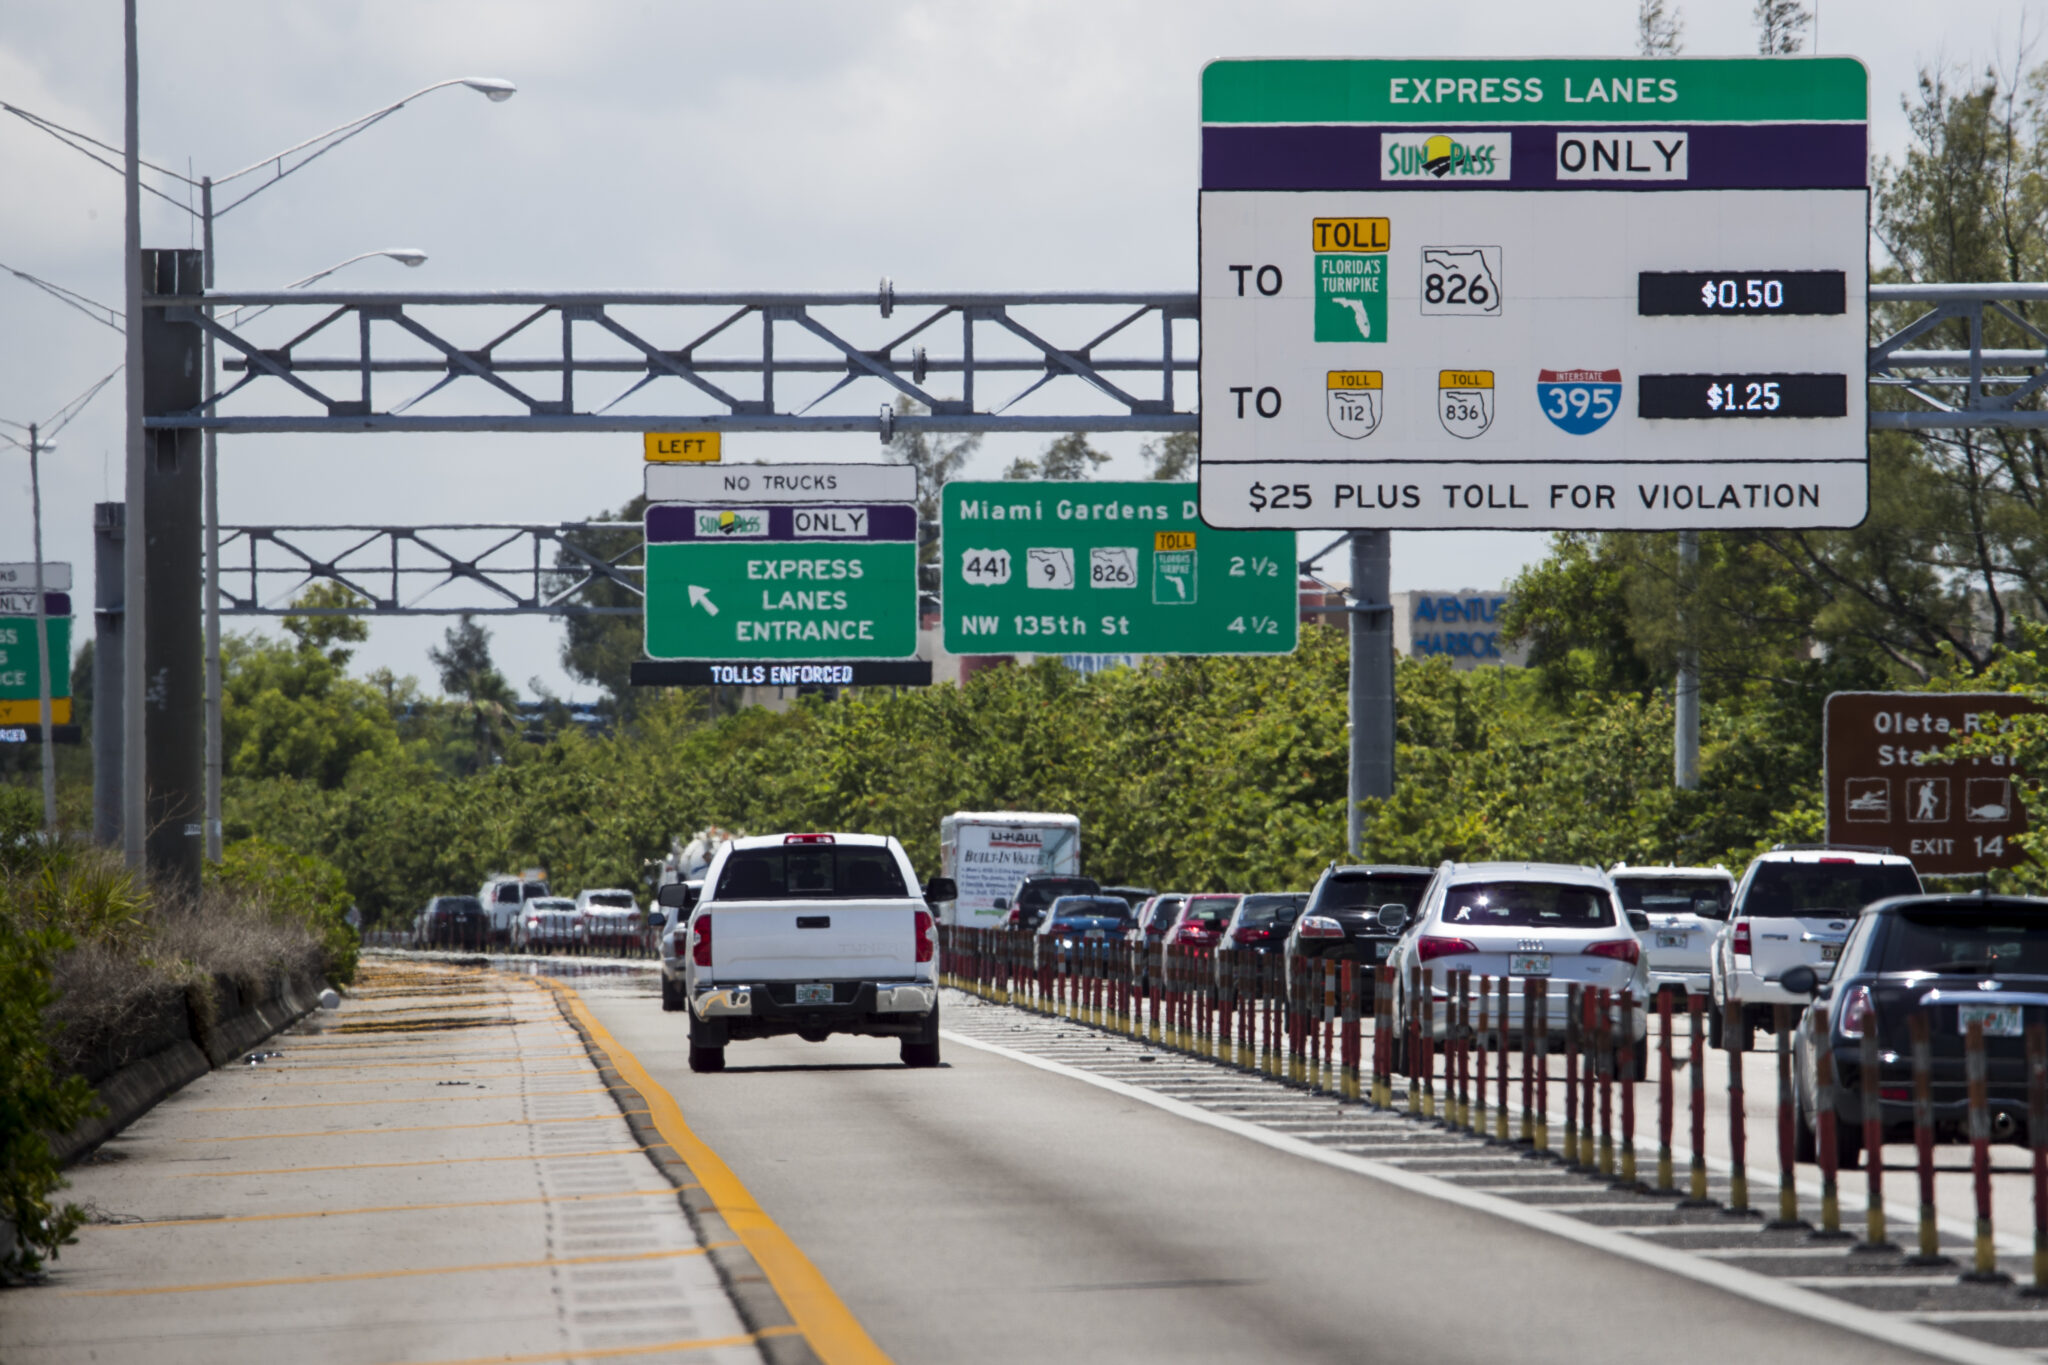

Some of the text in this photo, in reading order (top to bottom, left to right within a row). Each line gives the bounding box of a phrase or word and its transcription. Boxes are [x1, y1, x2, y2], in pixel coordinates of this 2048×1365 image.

[1389, 77, 1678, 104] EXPRESS LANES
[1560, 139, 1684, 172] ONLY
[1317, 222, 1387, 248] TOLL
[1321, 259, 1381, 275] FLORIDA'S
[1229, 264, 1283, 297] TO
[1322, 277, 1379, 293] TURNPIKE
[1425, 273, 1490, 305] 826
[1702, 280, 1784, 308] $0.50
[1340, 374, 1370, 387] TOLL
[1451, 374, 1482, 386] TOLL
[1556, 372, 1603, 382] INTERSTATE
[1229, 386, 1282, 419] TO
[1547, 388, 1614, 420] 395
[1706, 382, 1781, 411] $1.25
[1339, 405, 1364, 421] 112
[1446, 405, 1479, 421] 836
[657, 440, 706, 454] LEFT
[724, 475, 837, 490] NO TRUCKS
[1249, 482, 1820, 512] $25 PLUS TOLL FOR VIOLATION
[960, 500, 1198, 520] Miami Gardens D
[795, 513, 864, 532] ONLY
[1160, 534, 1191, 549] TOLL
[747, 560, 864, 580] EXPRESS
[966, 557, 1007, 578] 441
[1044, 563, 1056, 582] 9
[1093, 564, 1129, 582] 826
[762, 590, 848, 610] LANES
[1414, 595, 1505, 623] AVENTU
[736, 621, 874, 642] ENTRANCE
[961, 615, 1130, 636] NW 135th St
[710, 665, 853, 683] TOLLS ENFORCED
[1874, 711, 1950, 734] Oleta
[1878, 744, 1955, 767] Sta
[1910, 835, 2004, 858] EXIT 14
